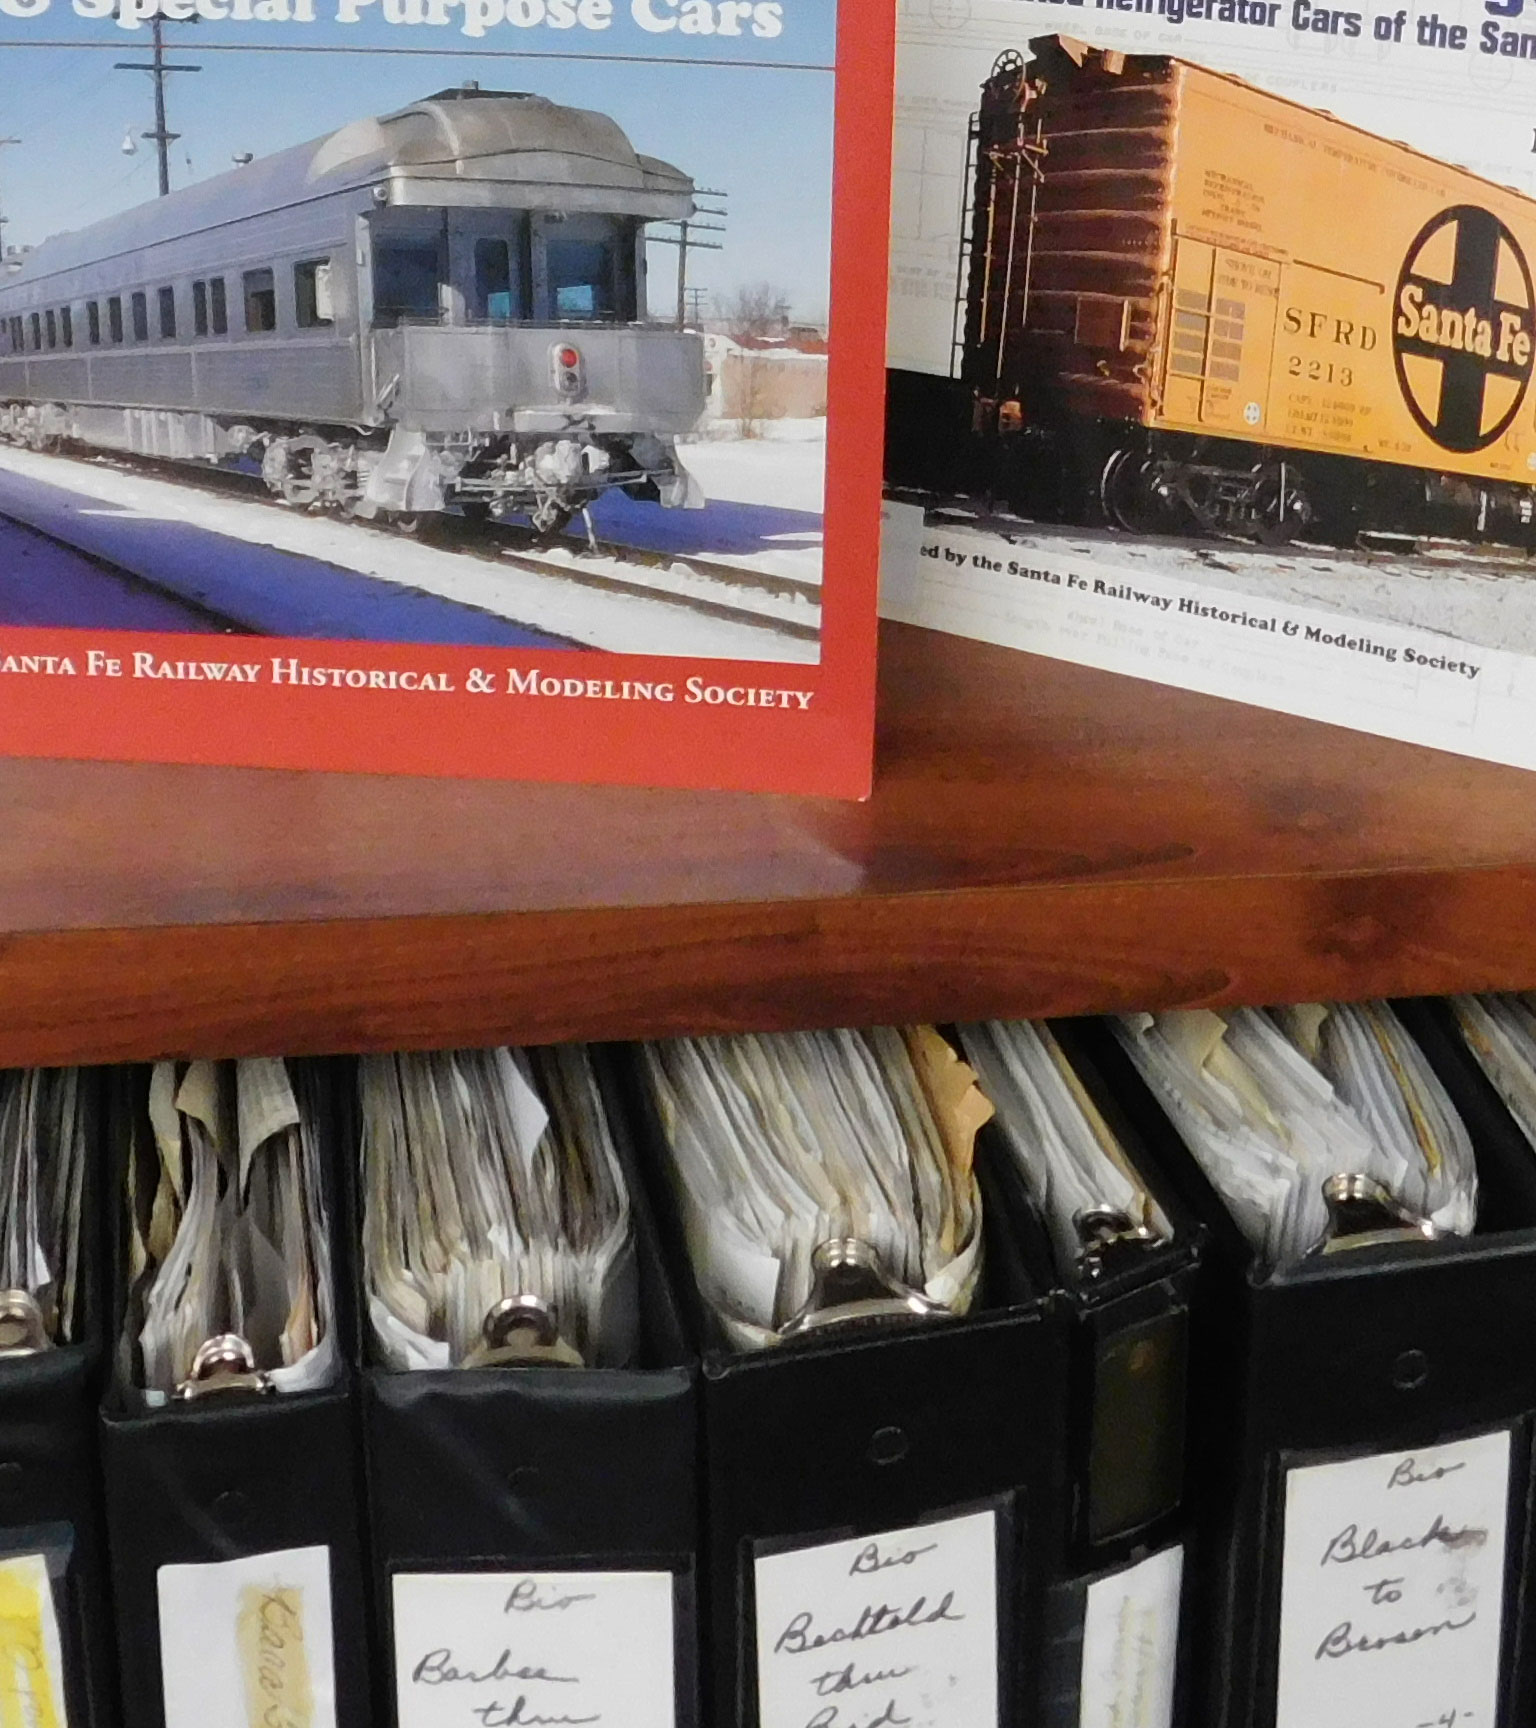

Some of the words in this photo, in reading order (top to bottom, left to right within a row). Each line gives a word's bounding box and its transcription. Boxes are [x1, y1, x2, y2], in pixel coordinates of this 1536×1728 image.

[1373, 10, 1407, 43] of
[1416, 13, 1468, 50] the
[1283, 306, 1378, 352] SFRD
[1397, 282, 1492, 359] Santa
[1495, 310, 1532, 367] Fe
[1288, 355, 1354, 388] 2213
[945, 547, 967, 567] by
[972, 554, 1003, 573] the
[1007, 561, 1061, 586] Santa
[1067, 573, 1088, 591] Fe
[1093, 579, 1173, 613] Railway
[1178, 597, 1276, 633] Historical
[1282, 619, 1300, 636] &
[1304, 625, 1397, 663] Modeling
[1403, 647, 1480, 679] Society
[86, 649, 123, 678] FE
[132, 651, 261, 683] RAILWAY
[271, 658, 455, 693] HISTORICAL
[465, 668, 495, 694] &
[506, 668, 674, 702] MODELING
[684, 677, 815, 711] SOCIETY
[1320, 1514, 1459, 1567] Black
[504, 1578, 597, 1614] Bio
[1363, 1577, 1406, 1605] to
